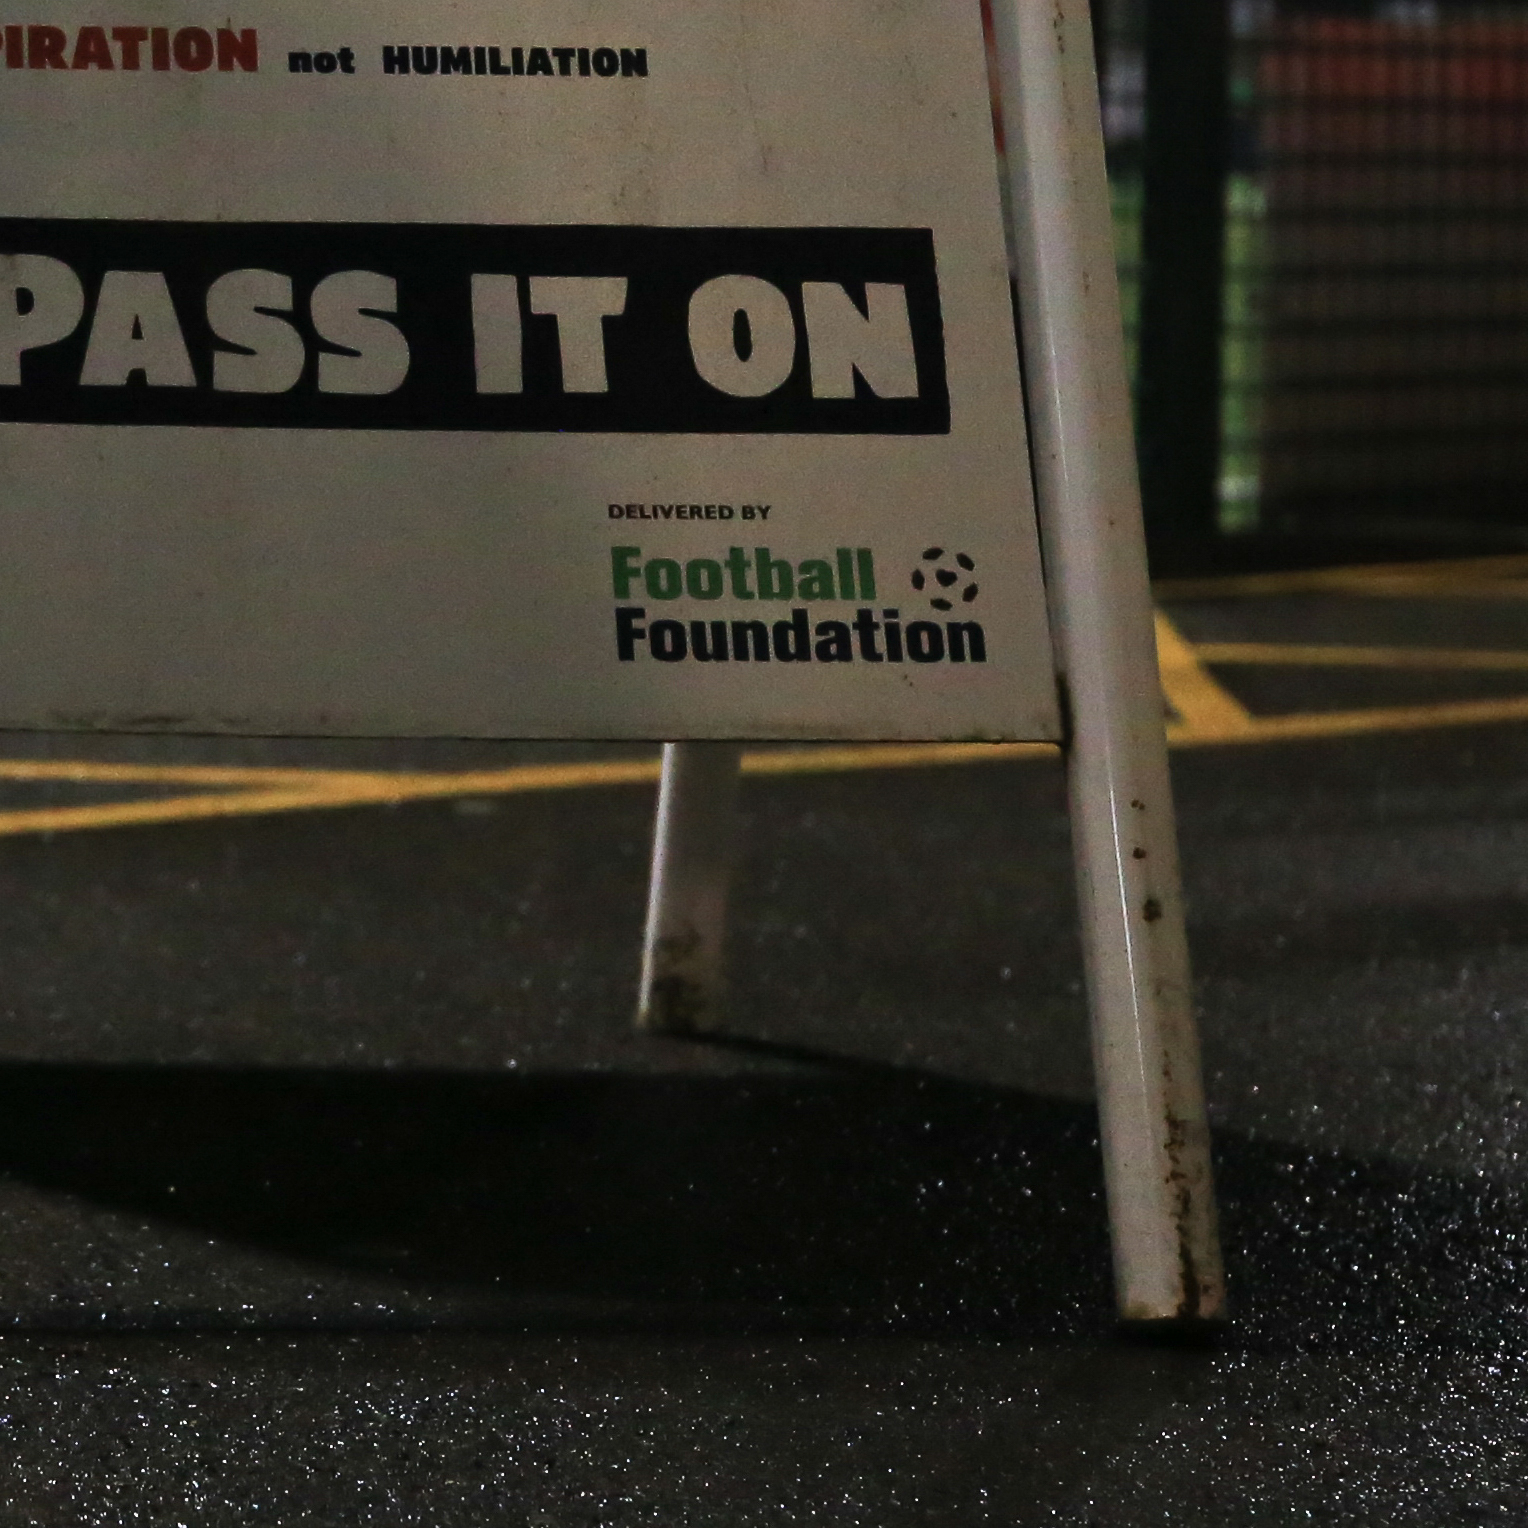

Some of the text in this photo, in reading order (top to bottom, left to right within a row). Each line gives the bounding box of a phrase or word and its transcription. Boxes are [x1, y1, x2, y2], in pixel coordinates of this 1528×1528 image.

[288, 47, 355, 74] not
[383, 45, 648, 76] HUMILIATION
[471, 273, 628, 395] IT
[688, 274, 919, 399] ON
[608, 504, 771, 520] DELIVERED BY
[611, 545, 876, 601] Football
[615, 607, 986, 663] Foundation
